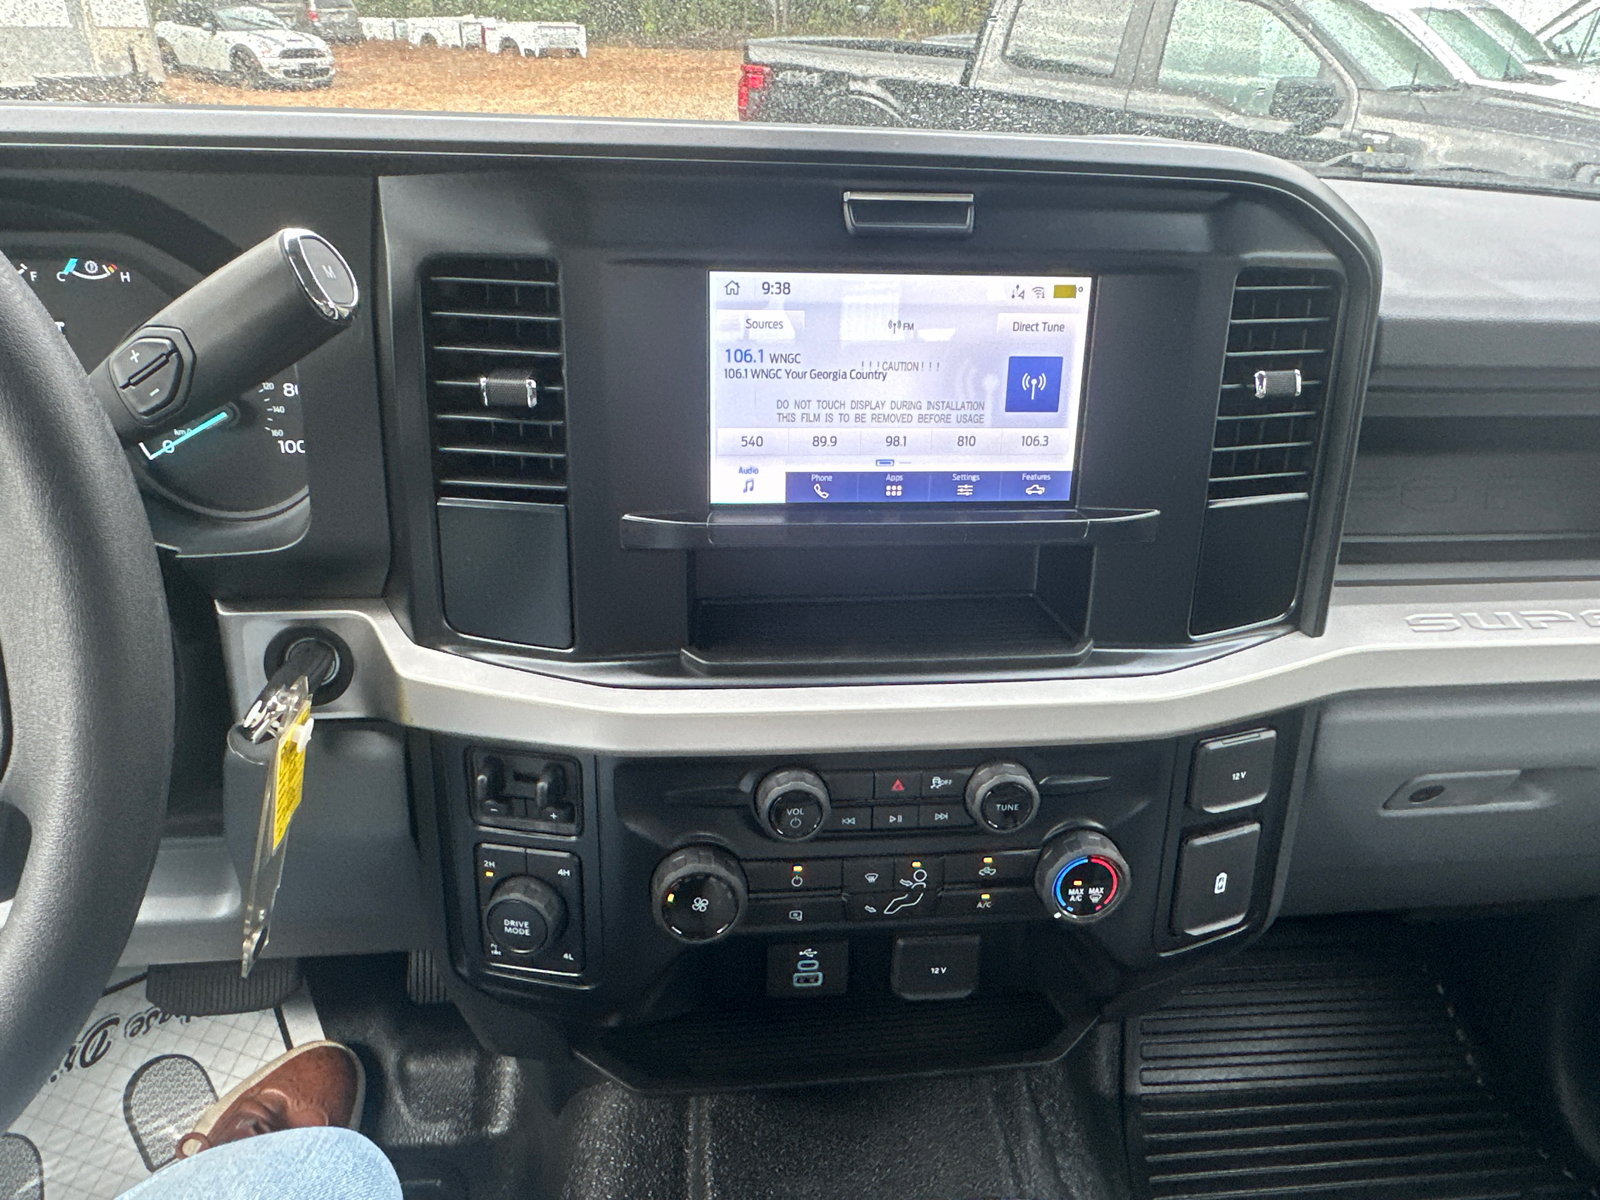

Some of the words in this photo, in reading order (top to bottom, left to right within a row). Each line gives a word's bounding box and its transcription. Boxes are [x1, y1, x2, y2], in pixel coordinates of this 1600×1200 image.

[29, 271, 37, 281] F
[56, 272, 66, 282] C
[120, 271, 131, 282] H
[761, 281, 791, 296] 9:38
[745, 318, 784, 330] Sources
[903, 322, 915, 331] FM
[1012, 321, 1039, 333] Direct
[1041, 322, 1065, 333] Tune
[725, 348, 764, 363] 106.1
[769, 353, 801, 364] WNGC
[724, 368, 748, 380] 106.1
[751, 368, 782, 380] WNGC
[786, 368, 807, 380] Your
[809, 368, 847, 382] Georgia
[849, 368, 888, 382] Country
[776, 400, 789, 410] DO
[794, 400, 812, 410] NOT
[817, 400, 845, 410] TOUCH
[850, 400, 885, 410] DISPLAY
[890, 401, 922, 411] DURING
[927, 401, 985, 411] INSTALLATION
[777, 413, 796, 423] THIS
[801, 413, 820, 423] FILM
[825, 413, 834, 423] IS
[839, 413, 850, 423] TO
[855, 413, 866, 423] BE
[871, 413, 913, 423] REMOVED
[918, 413, 951, 424] BEFORE
[956, 413, 985, 424] USAGE
[741, 435, 764, 448] 540
[812, 435, 837, 448] 89.9
[885, 435, 907, 448] 98.1
[957, 435, 976, 448] 810
[1021, 435, 1049, 448] 106.3
[738, 466, 759, 475] Audio
[811, 473, 833, 482] Phone
[886, 473, 903, 483] Apps
[952, 473, 980, 483] Settings
[1021, 473, 1051, 482] Features
[483, 860, 496, 868] 2H
[557, 868, 571, 876] 4H
[976, 901, 992, 909] A/C
[503, 919, 530, 928] DRIVE
[504, 927, 531, 936] MODE
[563, 952, 574, 961] 4L
